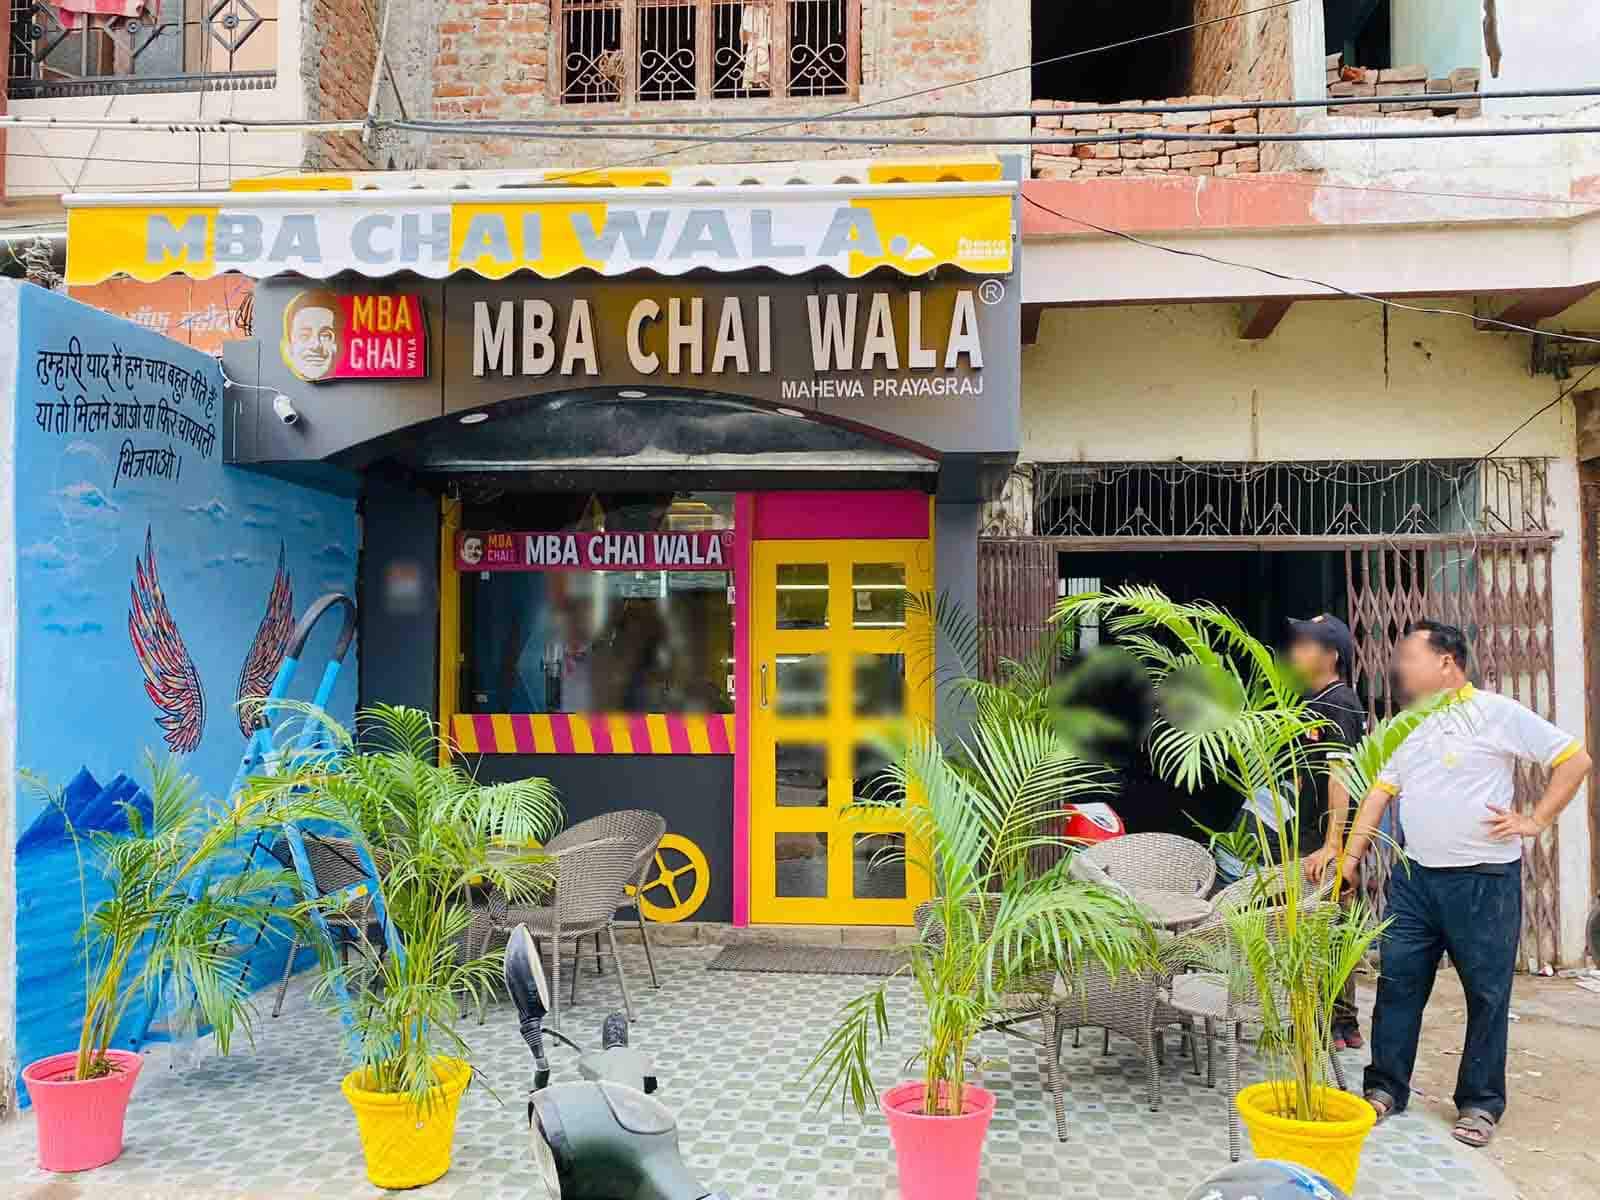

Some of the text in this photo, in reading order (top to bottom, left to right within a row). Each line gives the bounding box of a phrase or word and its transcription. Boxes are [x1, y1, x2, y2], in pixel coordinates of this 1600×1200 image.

[144, 212, 323, 263] MBA
[351, 213, 543, 264] CHAI
[352, 295, 412, 332] MBA
[472, 299, 599, 377] MBA
[627, 295, 771, 375] CHAI
[806, 289, 984, 371] WALA
[36, 336, 87, 391] तुम्हारी
[86, 354, 115, 392] याद
[111, 342, 122, 380] में
[125, 356, 143, 390] हम
[145, 359, 168, 386] चाय
[168, 364, 190, 404] बहुत
[190, 369, 207, 406] पीते
[351, 337, 403, 369] CHAI
[407, 337, 417, 369] WALA
[781, 376, 985, 400] MAHEWA PRAYAGRAJ
[36, 402, 54, 432] या
[56, 395, 71, 435] तो
[73, 395, 112, 432] मिलने
[111, 395, 141, 430] आओ
[143, 403, 156, 429] या
[157, 398, 178, 437] फिर
[525, 534, 579, 565] MBA
[587, 533, 645, 565] CHAI
[653, 533, 723, 565] WALA
